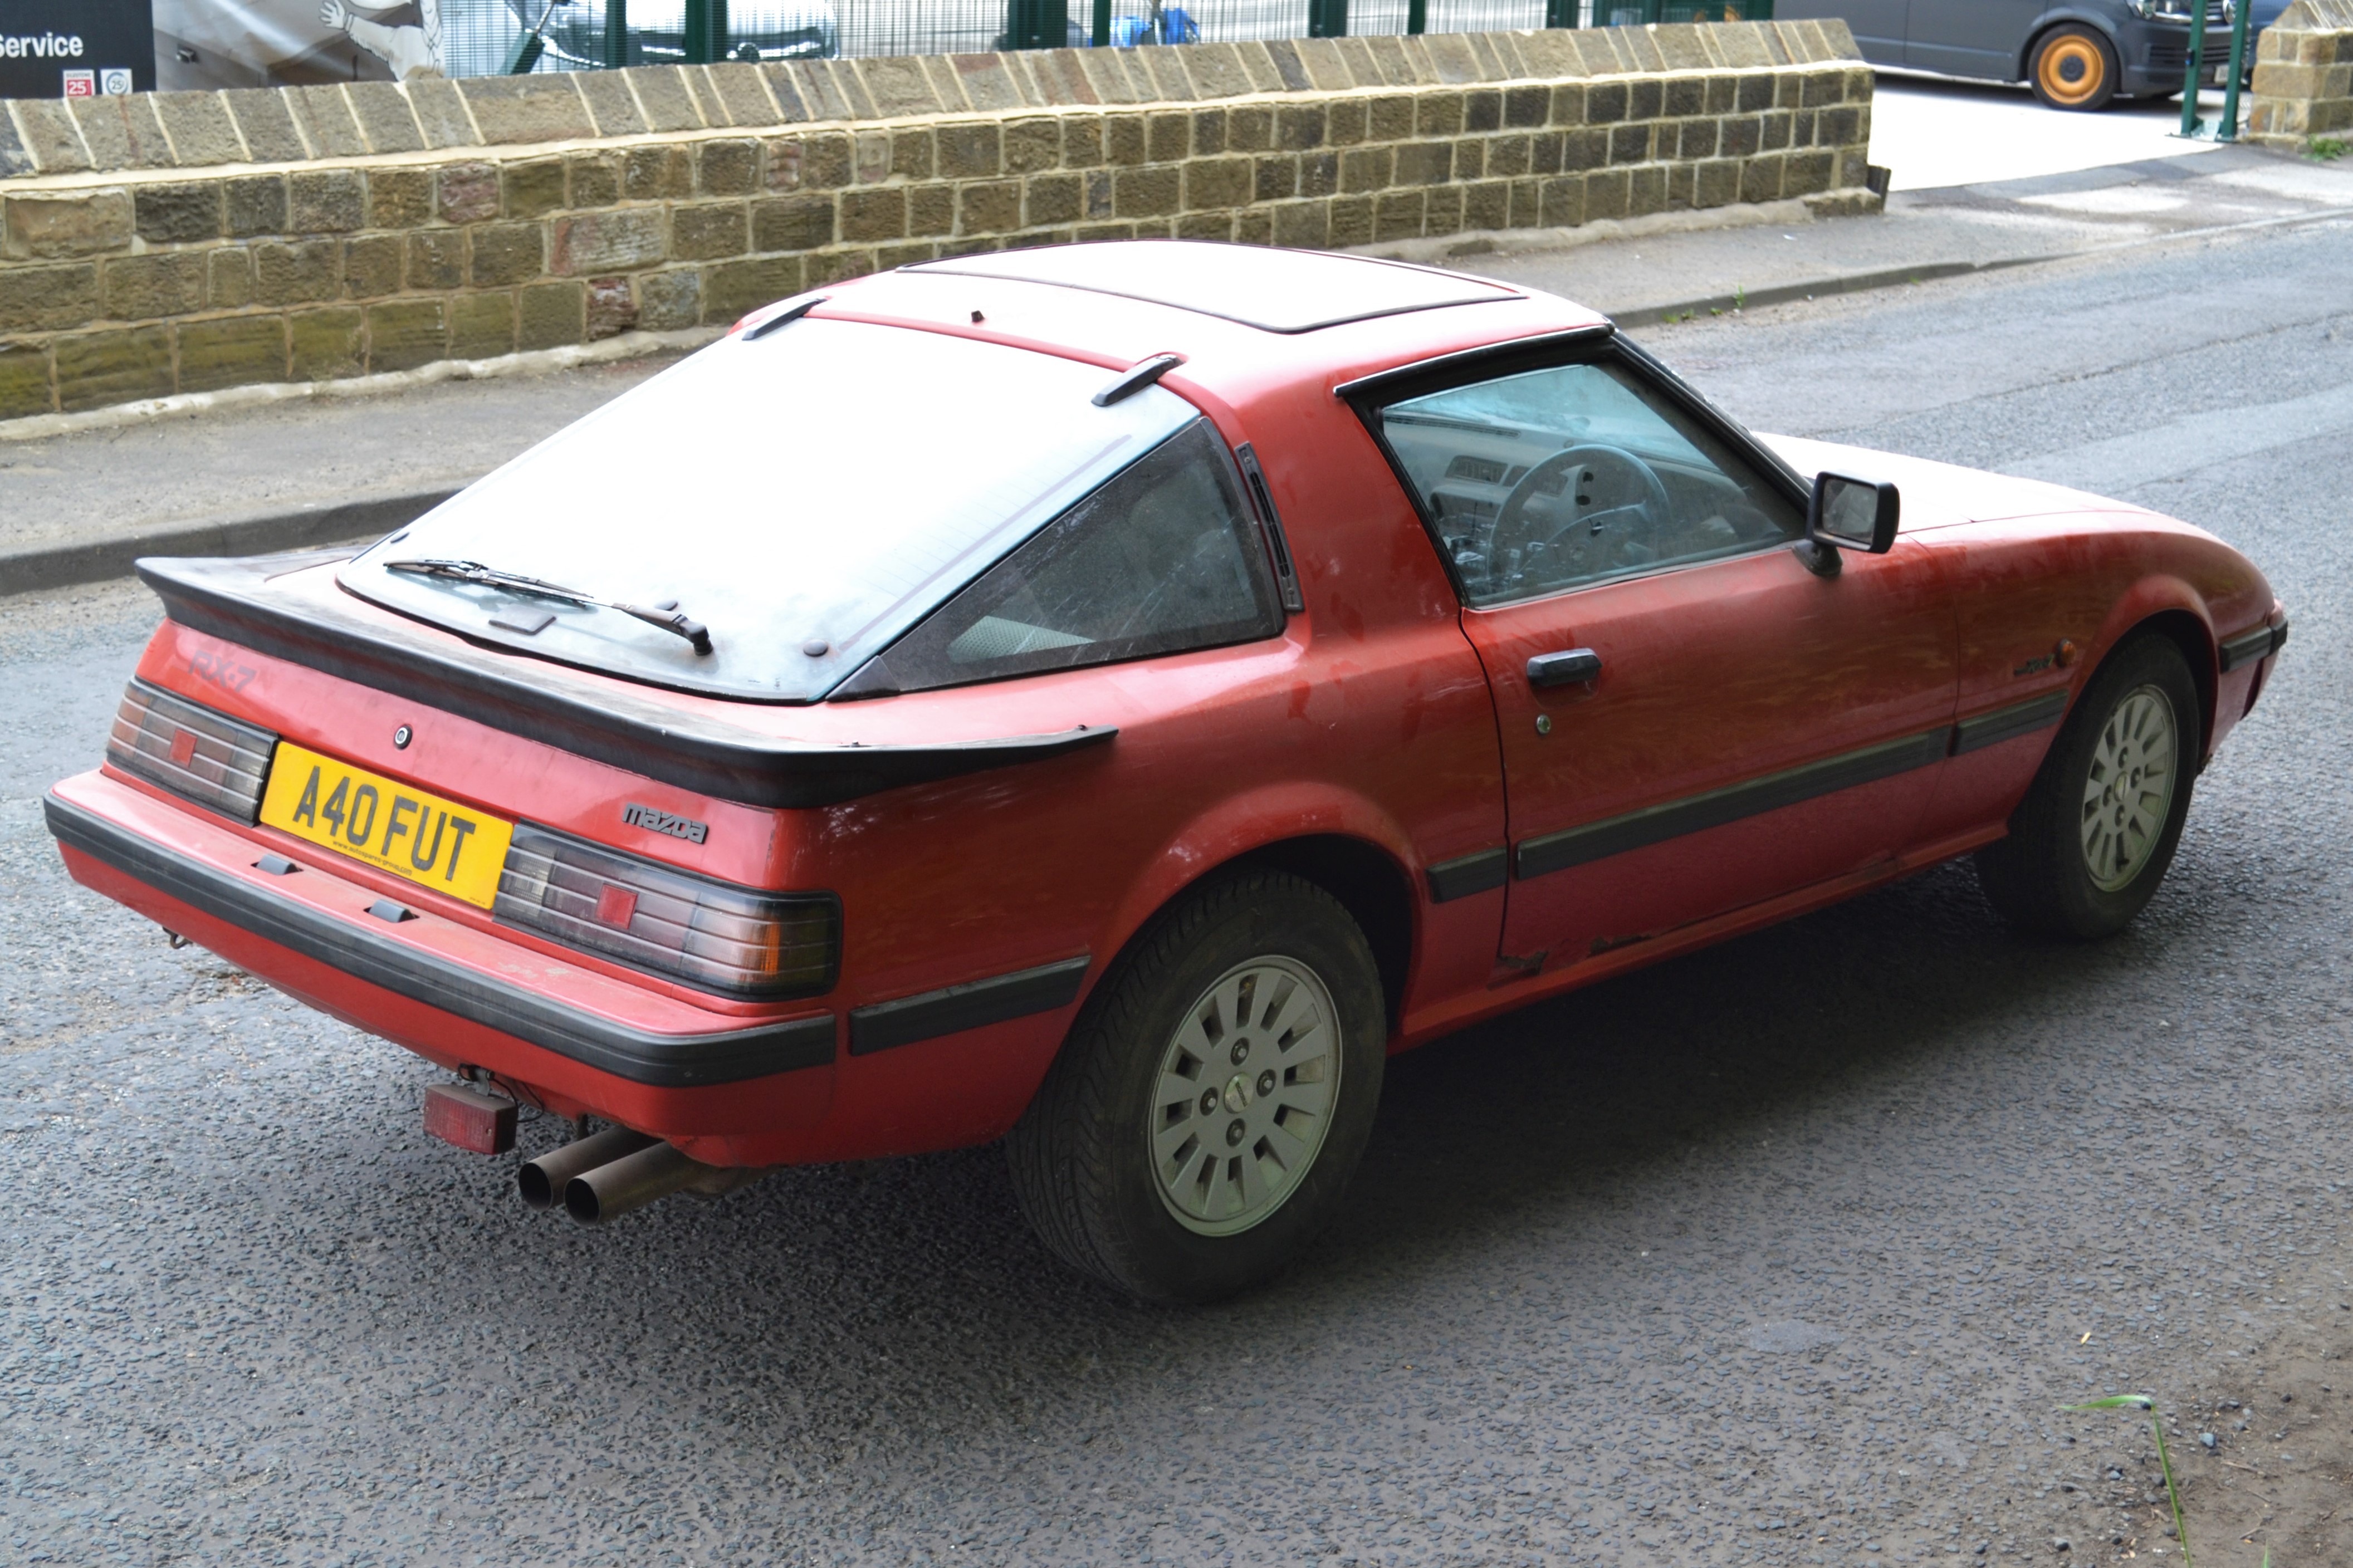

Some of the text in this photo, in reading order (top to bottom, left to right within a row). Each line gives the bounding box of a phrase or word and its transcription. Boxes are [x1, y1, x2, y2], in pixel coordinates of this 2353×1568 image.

[69, 81, 87, 95] 25
[292, 765, 477, 881] A40 FUT
[333, 841, 413, 876] www.autospares-group.com
